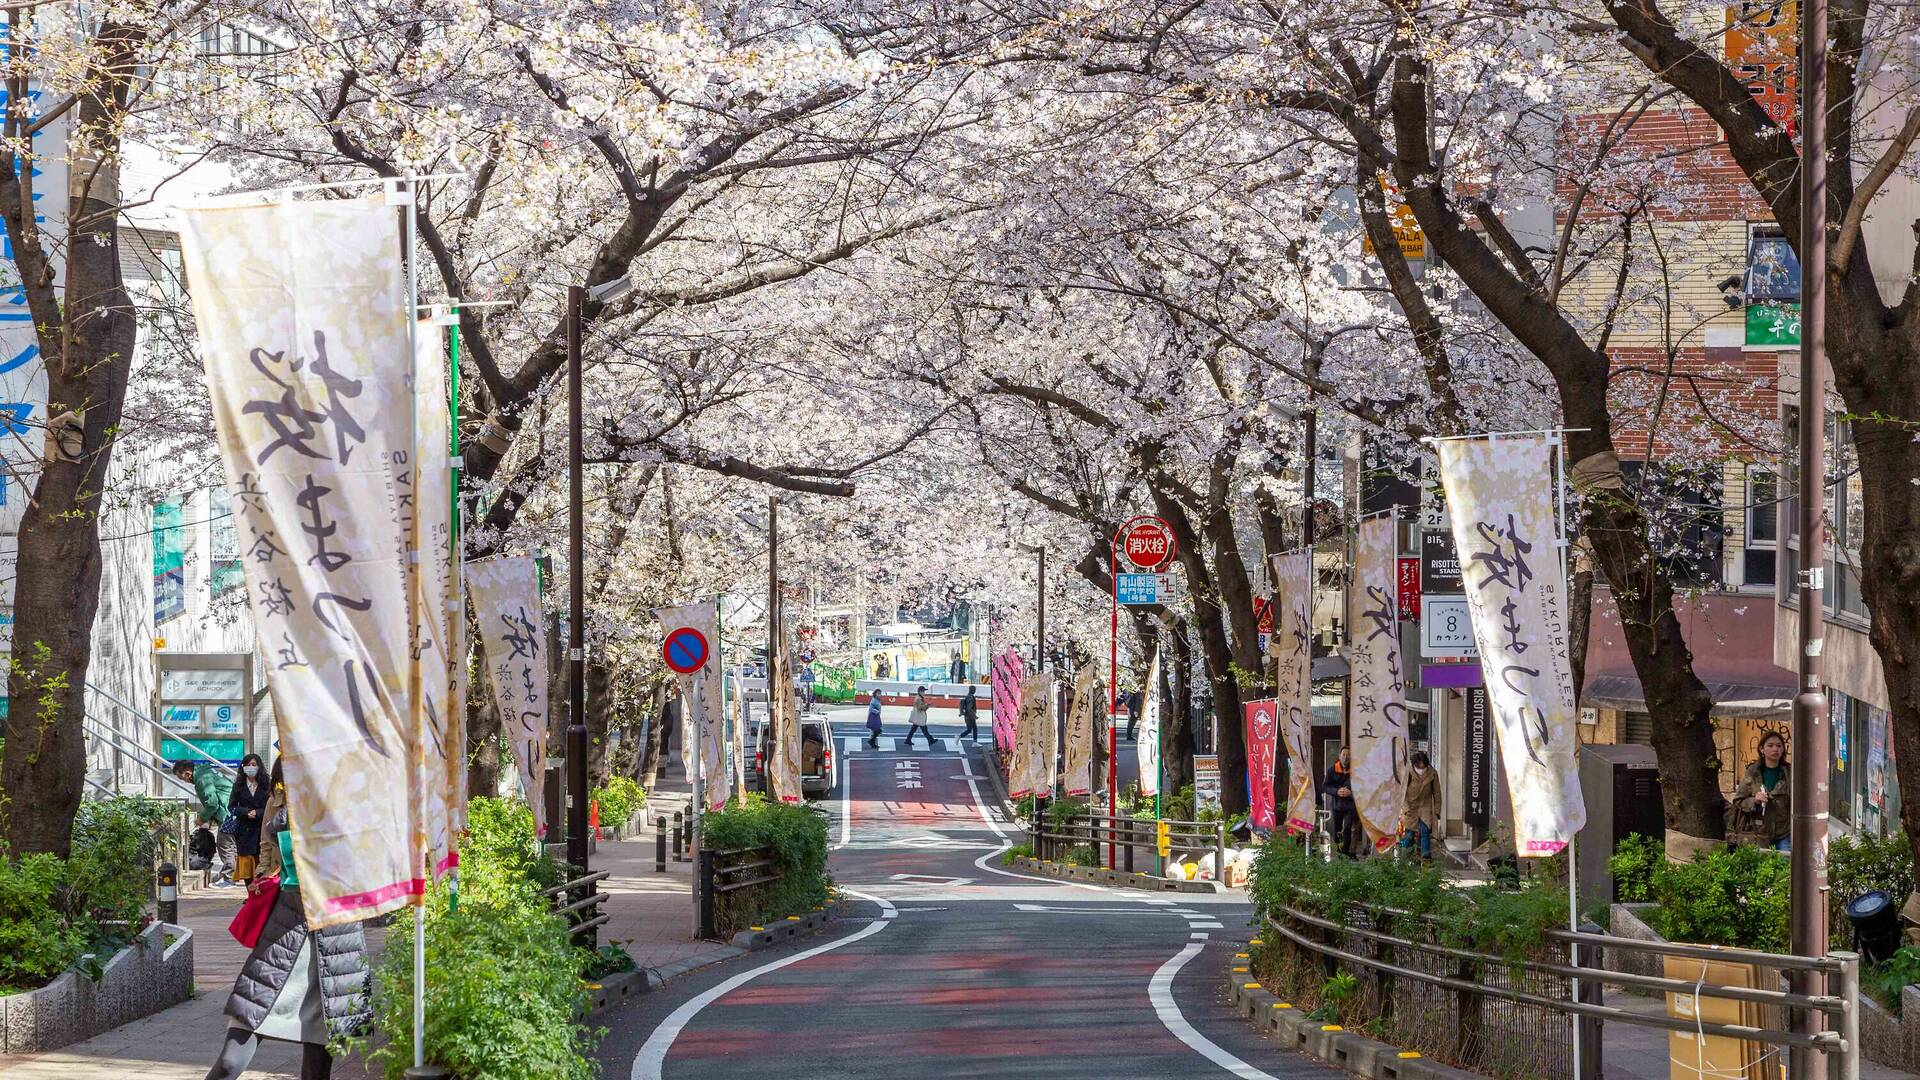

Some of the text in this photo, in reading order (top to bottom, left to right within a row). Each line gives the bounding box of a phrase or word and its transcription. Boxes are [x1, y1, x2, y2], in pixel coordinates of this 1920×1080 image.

[1427, 514, 1443, 525] 2F
[1129, 537, 1165, 554] 消火栓
[1120, 576, 1155, 588] 青山製図
[1120, 587, 1155, 595] 専門学校
[1446, 615, 1457, 632] 8
[895, 760, 924, 789] 止まれ
[1472, 754, 1480, 798] STANDARD
